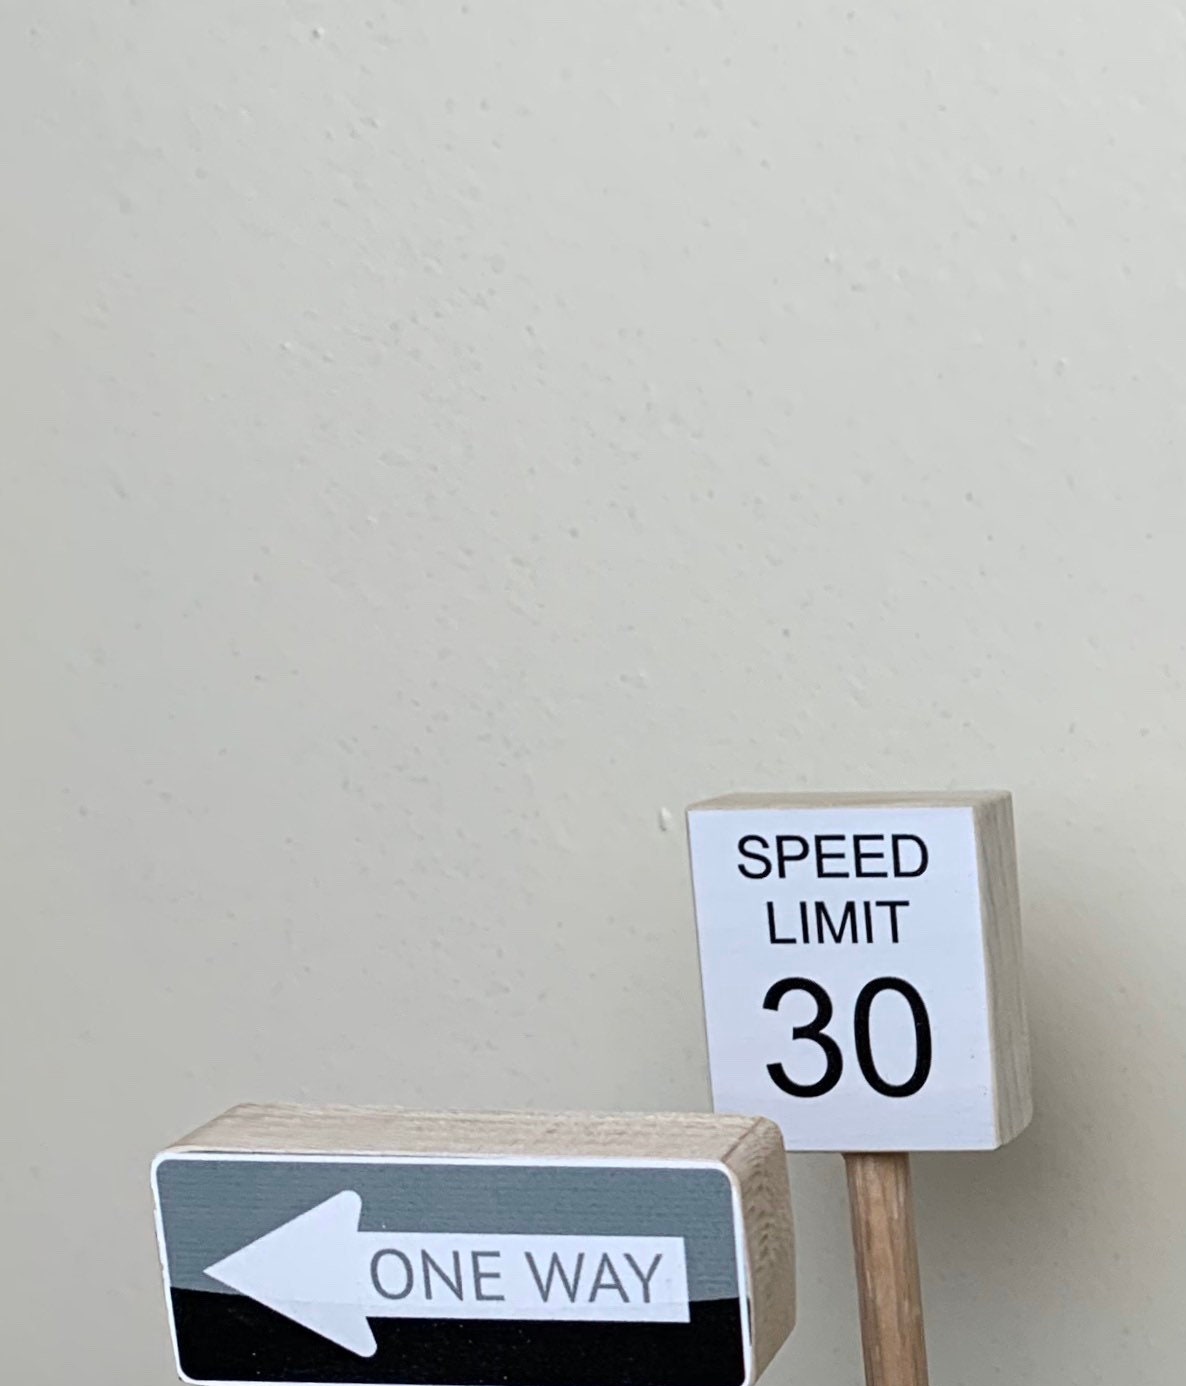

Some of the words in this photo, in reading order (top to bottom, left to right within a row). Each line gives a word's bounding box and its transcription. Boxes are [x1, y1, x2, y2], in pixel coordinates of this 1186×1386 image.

[737, 834, 929, 879] SPEED
[766, 901, 910, 944] LIMIT
[762, 976, 933, 1098] 30
[369, 1247, 505, 1302] ONE
[524, 1251, 663, 1304] WAY
